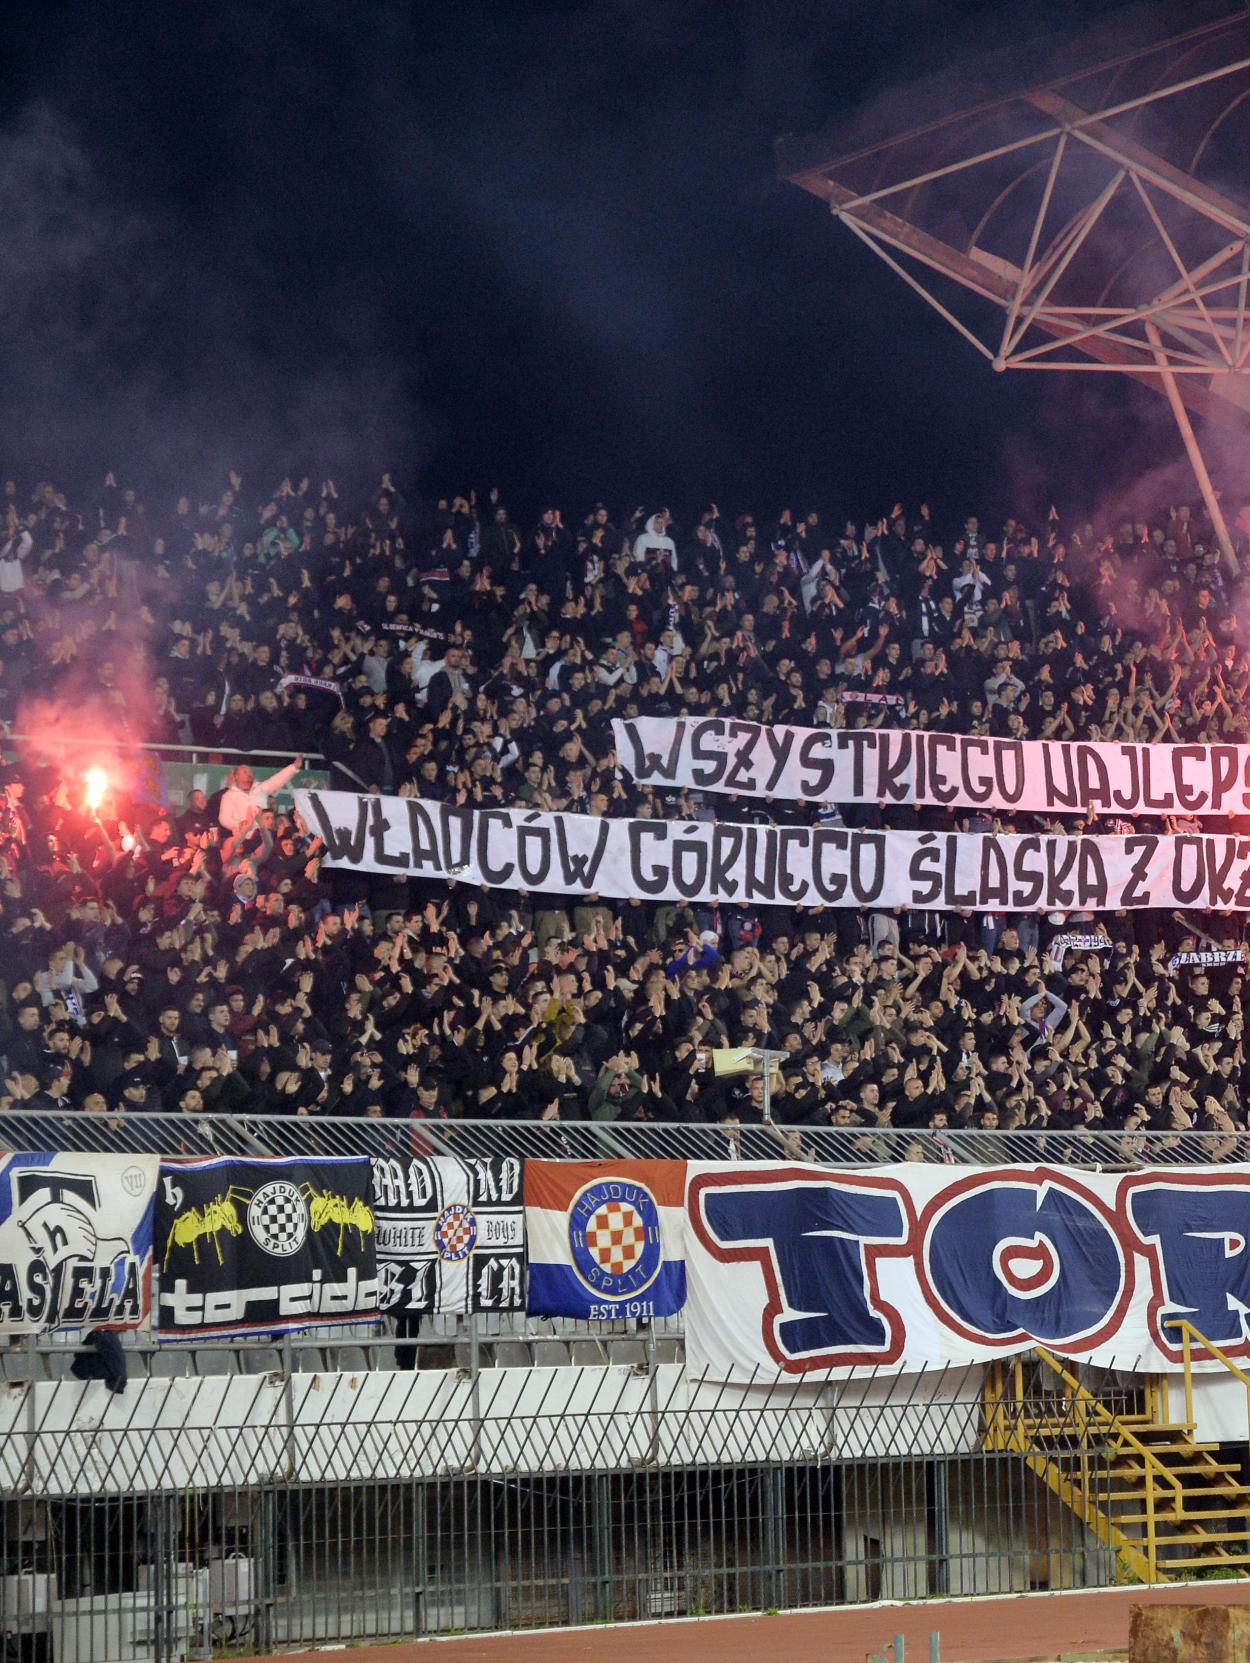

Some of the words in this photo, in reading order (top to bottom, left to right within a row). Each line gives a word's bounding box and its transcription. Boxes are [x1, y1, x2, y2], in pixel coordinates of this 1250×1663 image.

[622, 717, 1023, 804] WSZYSTKIEGO
[307, 792, 610, 889] WŁADCÓW
[629, 819, 886, 903] GÓRNEGO
[1121, 835, 1161, 906] Z
[577, 1184, 649, 1217] HAJDUK
[262, 1236, 301, 1252] SPLIT
[587, 1264, 648, 1293] SPLIT
